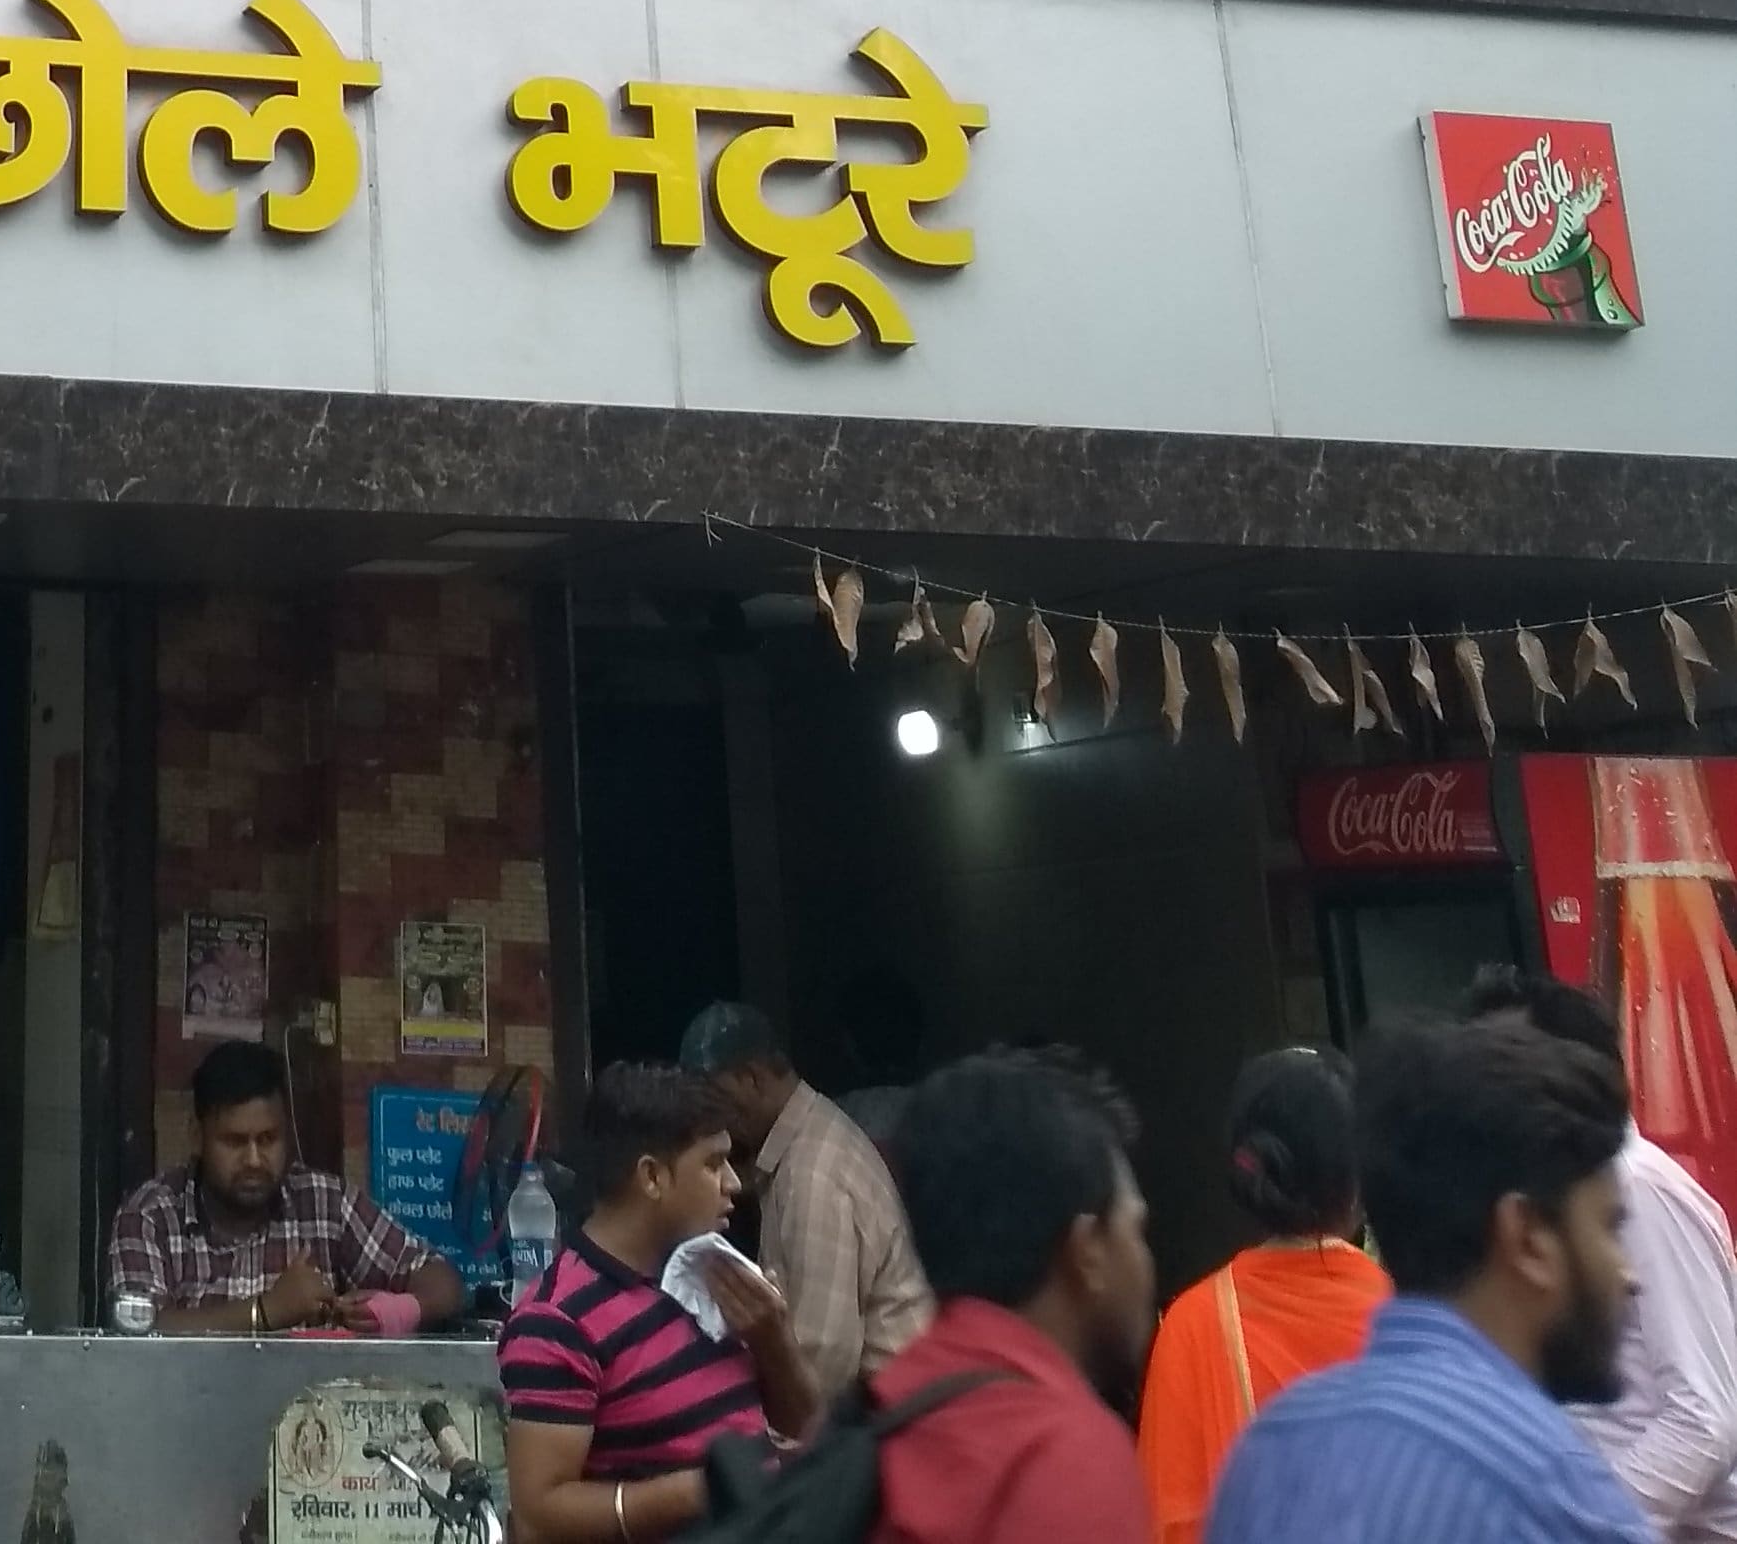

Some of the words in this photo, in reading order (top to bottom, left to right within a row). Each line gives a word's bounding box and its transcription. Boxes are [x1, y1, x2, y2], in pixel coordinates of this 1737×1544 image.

[507, 28, 989, 349] भटूरे
[1455, 132, 1574, 273] Coca-Cola
[1328, 770, 1462, 856] Coca-Cola
